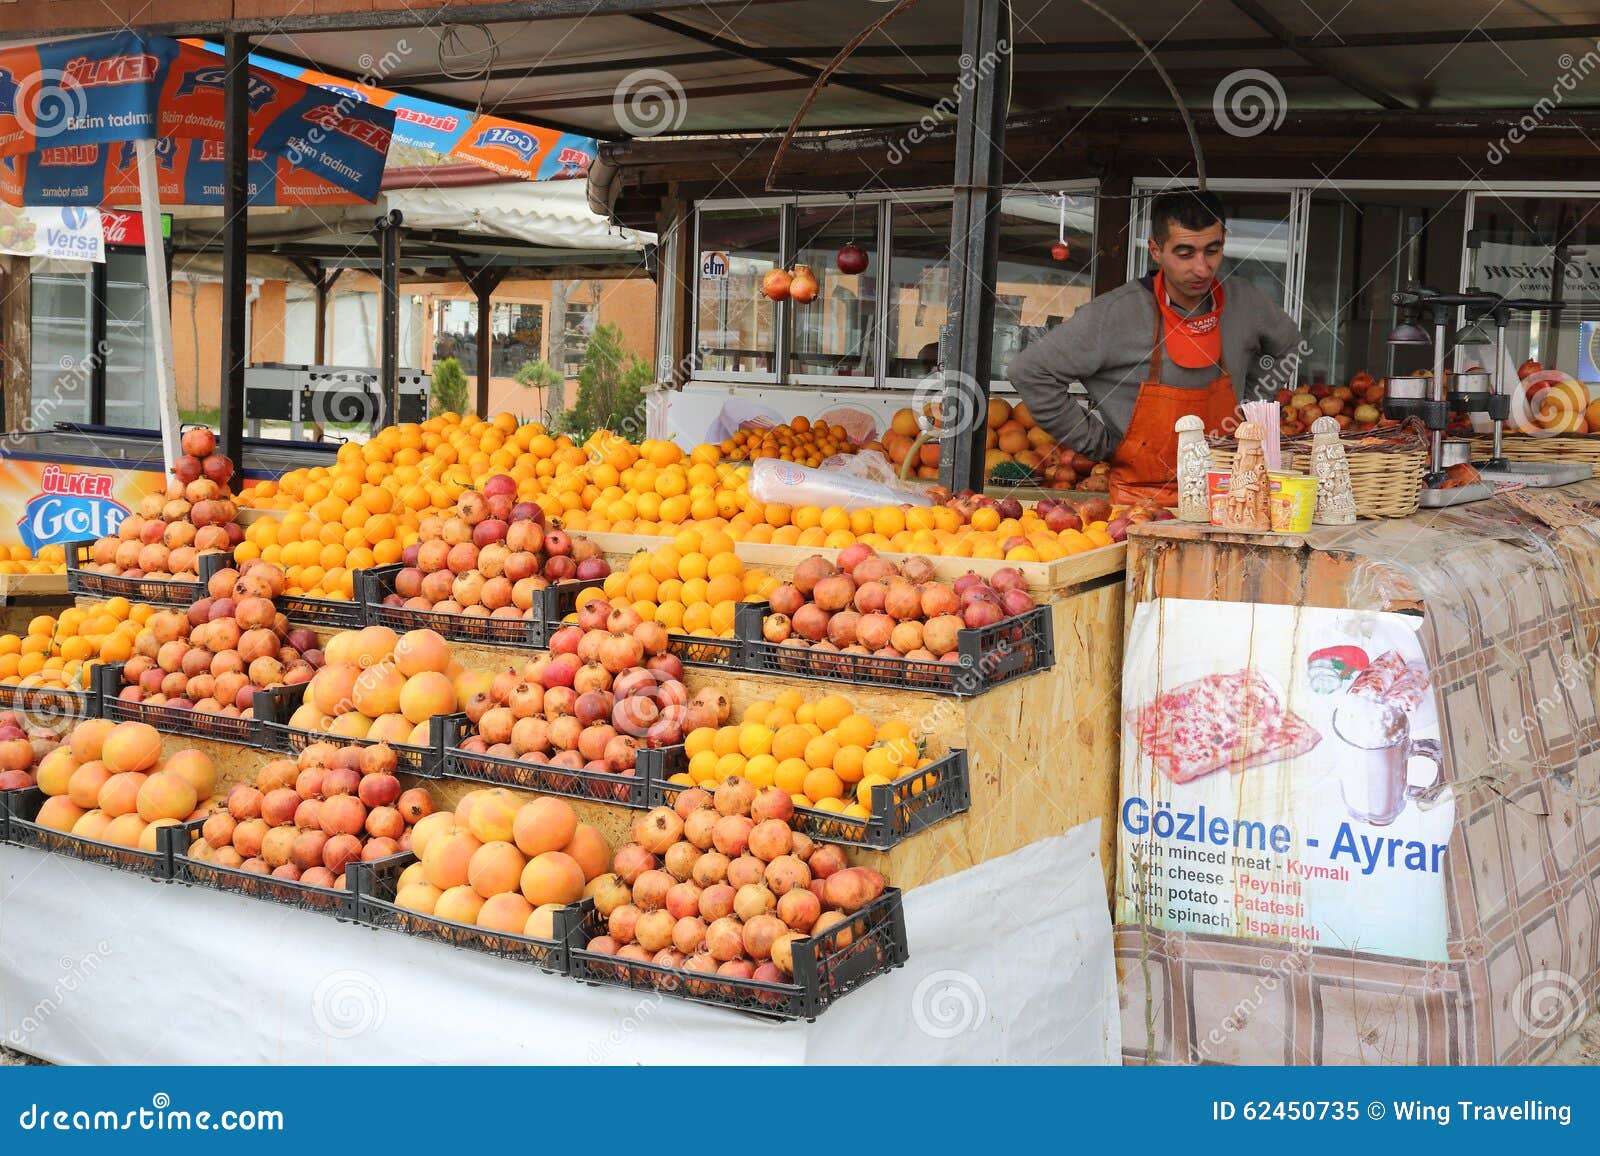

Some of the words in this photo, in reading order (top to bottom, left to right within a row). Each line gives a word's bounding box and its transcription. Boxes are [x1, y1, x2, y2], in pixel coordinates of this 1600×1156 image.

[67, 116, 104, 131] Bizim
[319, 151, 363, 182] tadımız
[47, 228, 99, 251] Versa
[41, 464, 114, 499] ÜLKER
[33, 498, 125, 540] Golf
[1122, 797, 1291, 853] Gözleme
[1168, 846, 1226, 864] minced
[1231, 855, 1272, 871] meat
[1287, 858, 1349, 881] Kıymalı
[1168, 866, 1224, 885] cheese
[1240, 873, 1302, 896] Peynirli
[1168, 888, 1218, 905] potato
[1234, 893, 1304, 917] Patatesli
[1168, 908, 1230, 927] spinach
